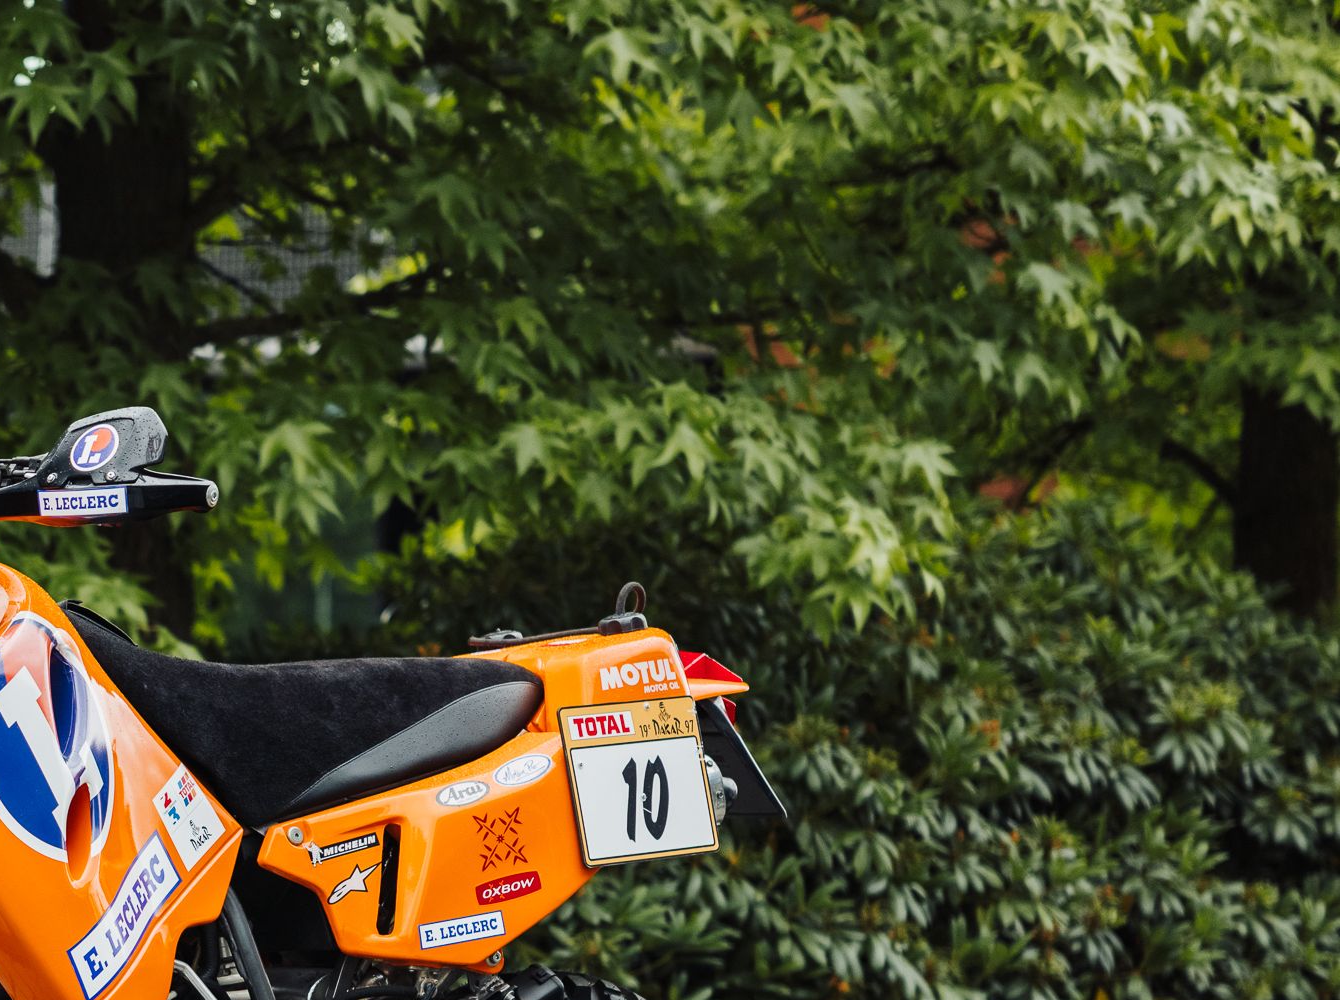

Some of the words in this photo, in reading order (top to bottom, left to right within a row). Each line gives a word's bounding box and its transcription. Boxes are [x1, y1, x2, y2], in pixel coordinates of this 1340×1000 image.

[43, 497, 54, 511] E.
[56, 494, 119, 511] LECLERC
[600, 658, 676, 691] MOTUL
[644, 684, 668, 694] MOTOR
[573, 714, 630, 738] TOTAL
[652, 717, 684, 736] DAKAR
[685, 720, 694, 734] 97
[179, 780, 195, 799] TOTAL
[622, 756, 669, 843] 10
[324, 835, 376, 857] MICHELIN
[482, 877, 535, 899] OXBOW
[83, 946, 109, 980] E.
[105, 854, 165, 957] LECLERC
[425, 930, 437, 942] E.
[440, 918, 498, 939] LECLERC
